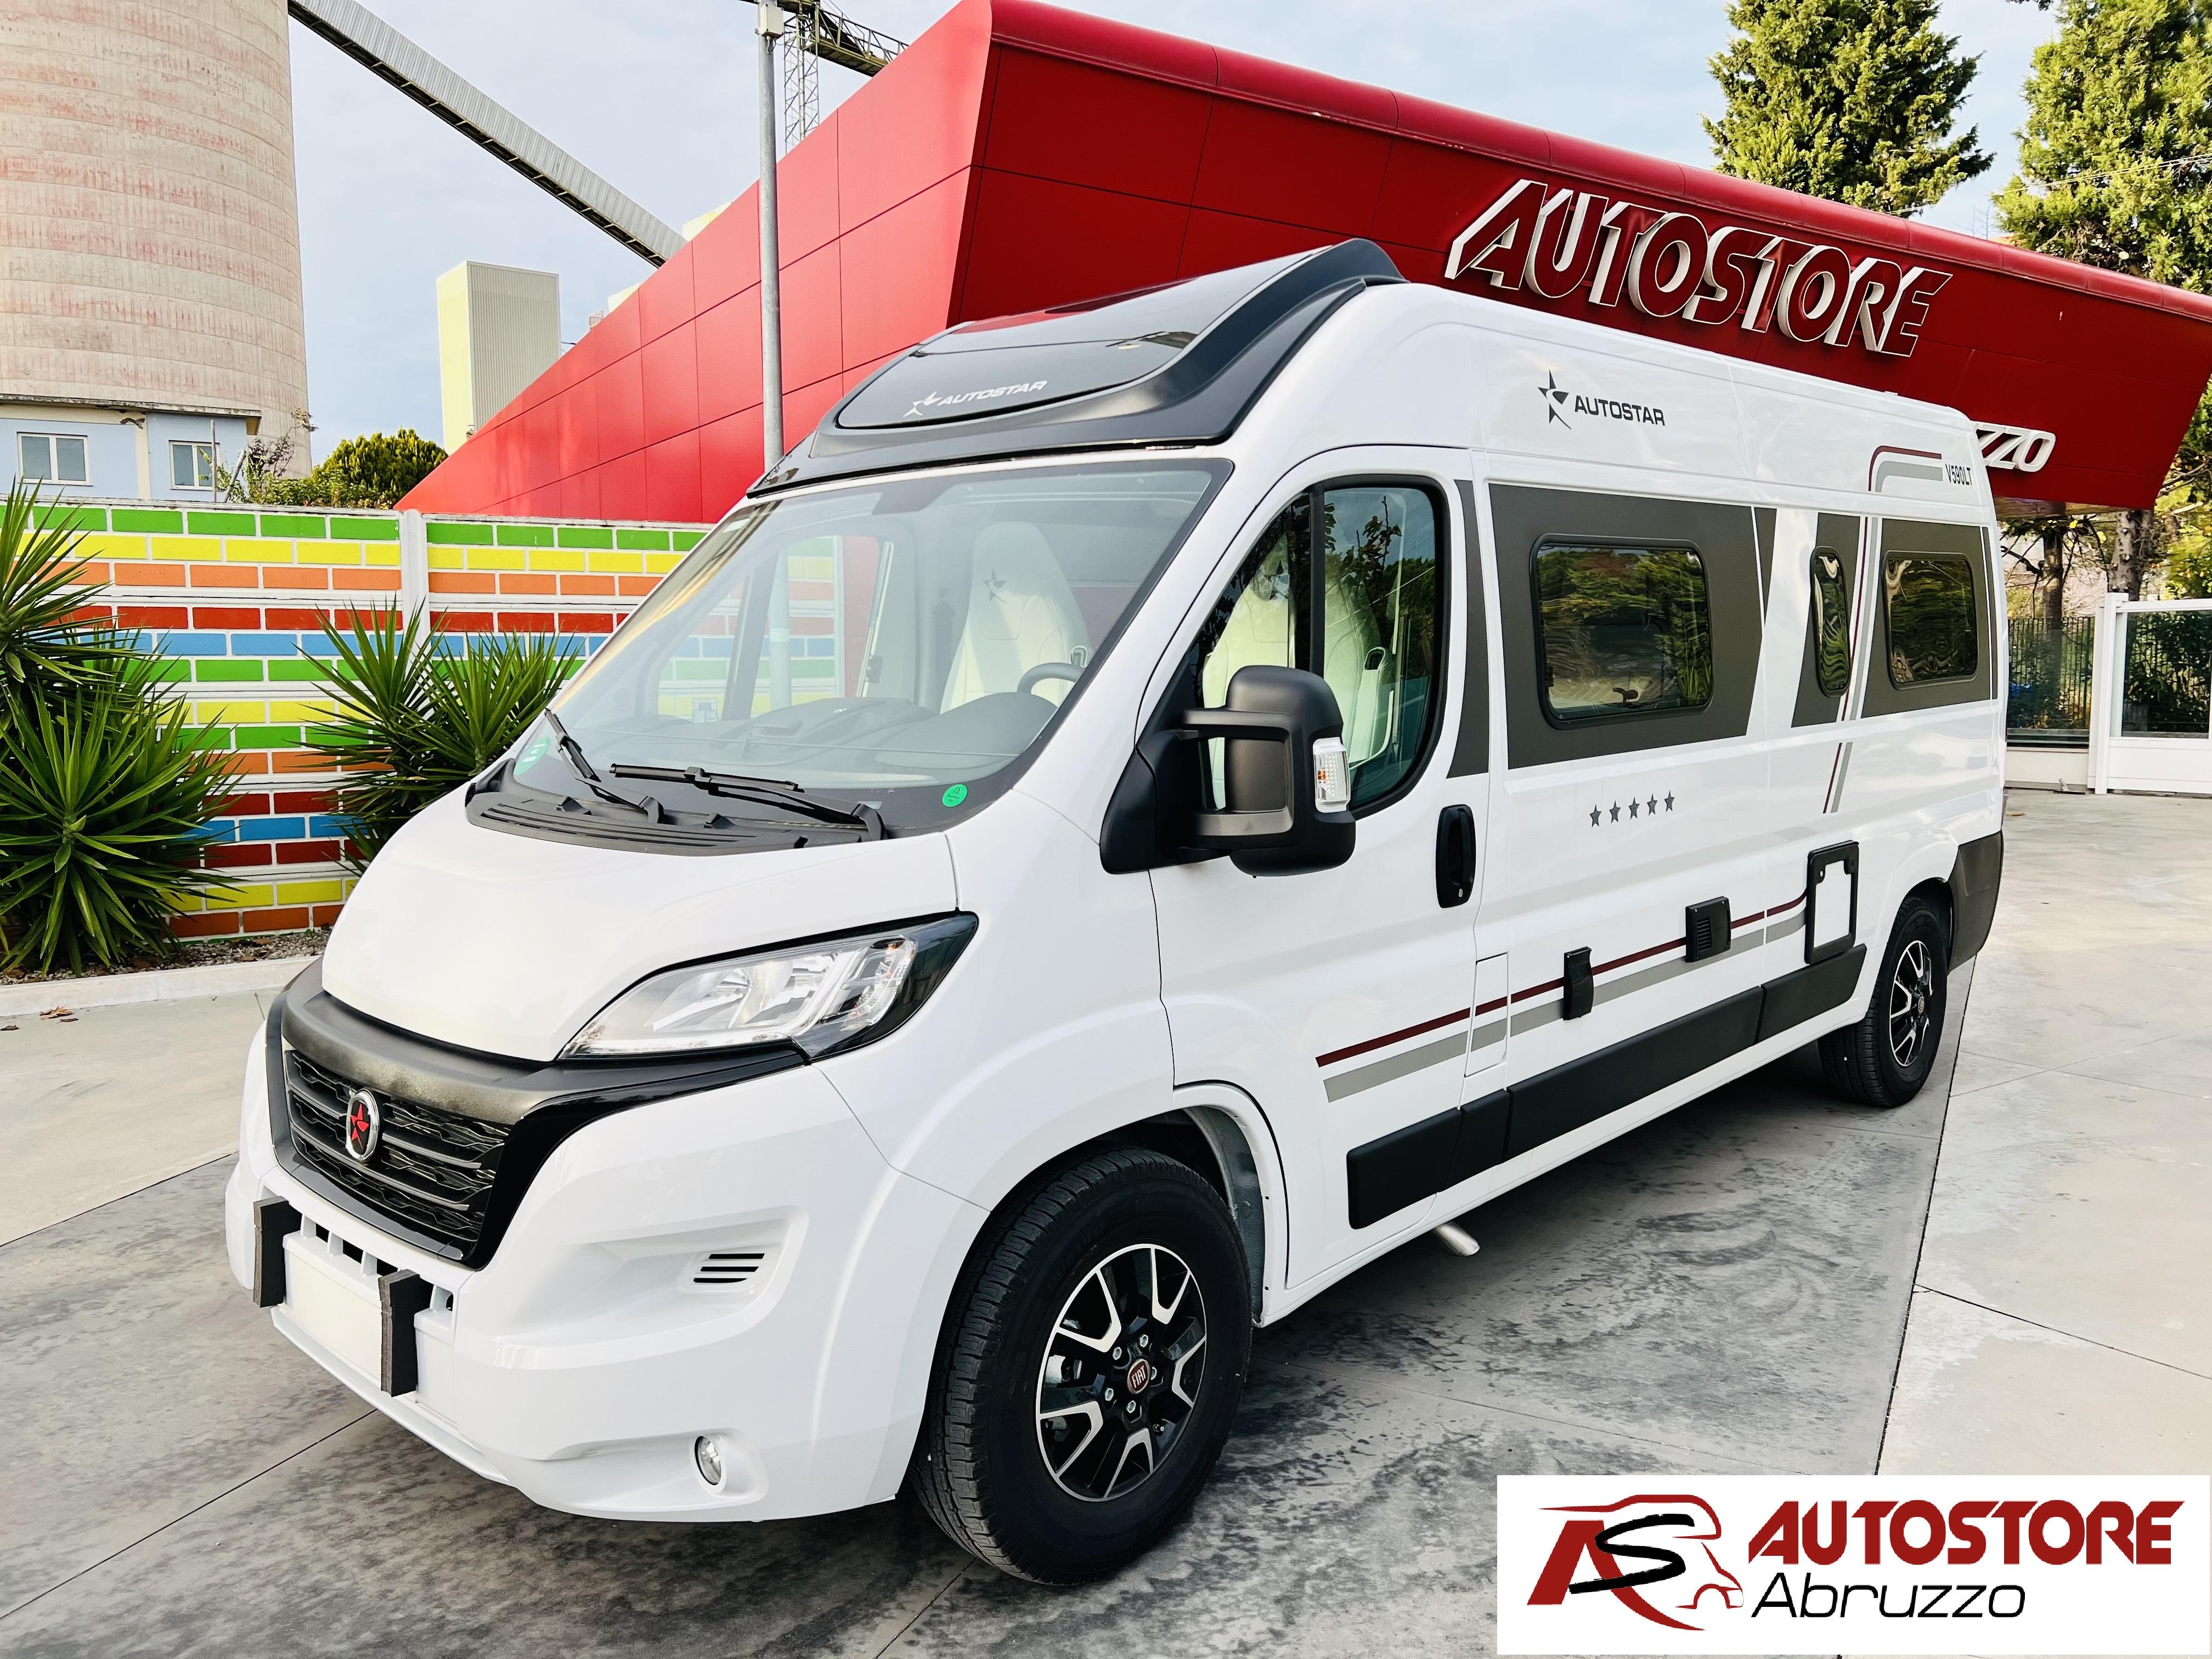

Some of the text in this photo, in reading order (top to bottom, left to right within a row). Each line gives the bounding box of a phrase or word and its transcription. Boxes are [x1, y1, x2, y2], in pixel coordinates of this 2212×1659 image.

[1444, 178, 1953, 358] AUTOSTORE
[936, 380, 1048, 407] AUTOSTAR
[1575, 395, 1666, 426] AUTOSTAR
[1945, 463, 1972, 486] V590LT
[1131, 1365, 1146, 1389] FIAT
